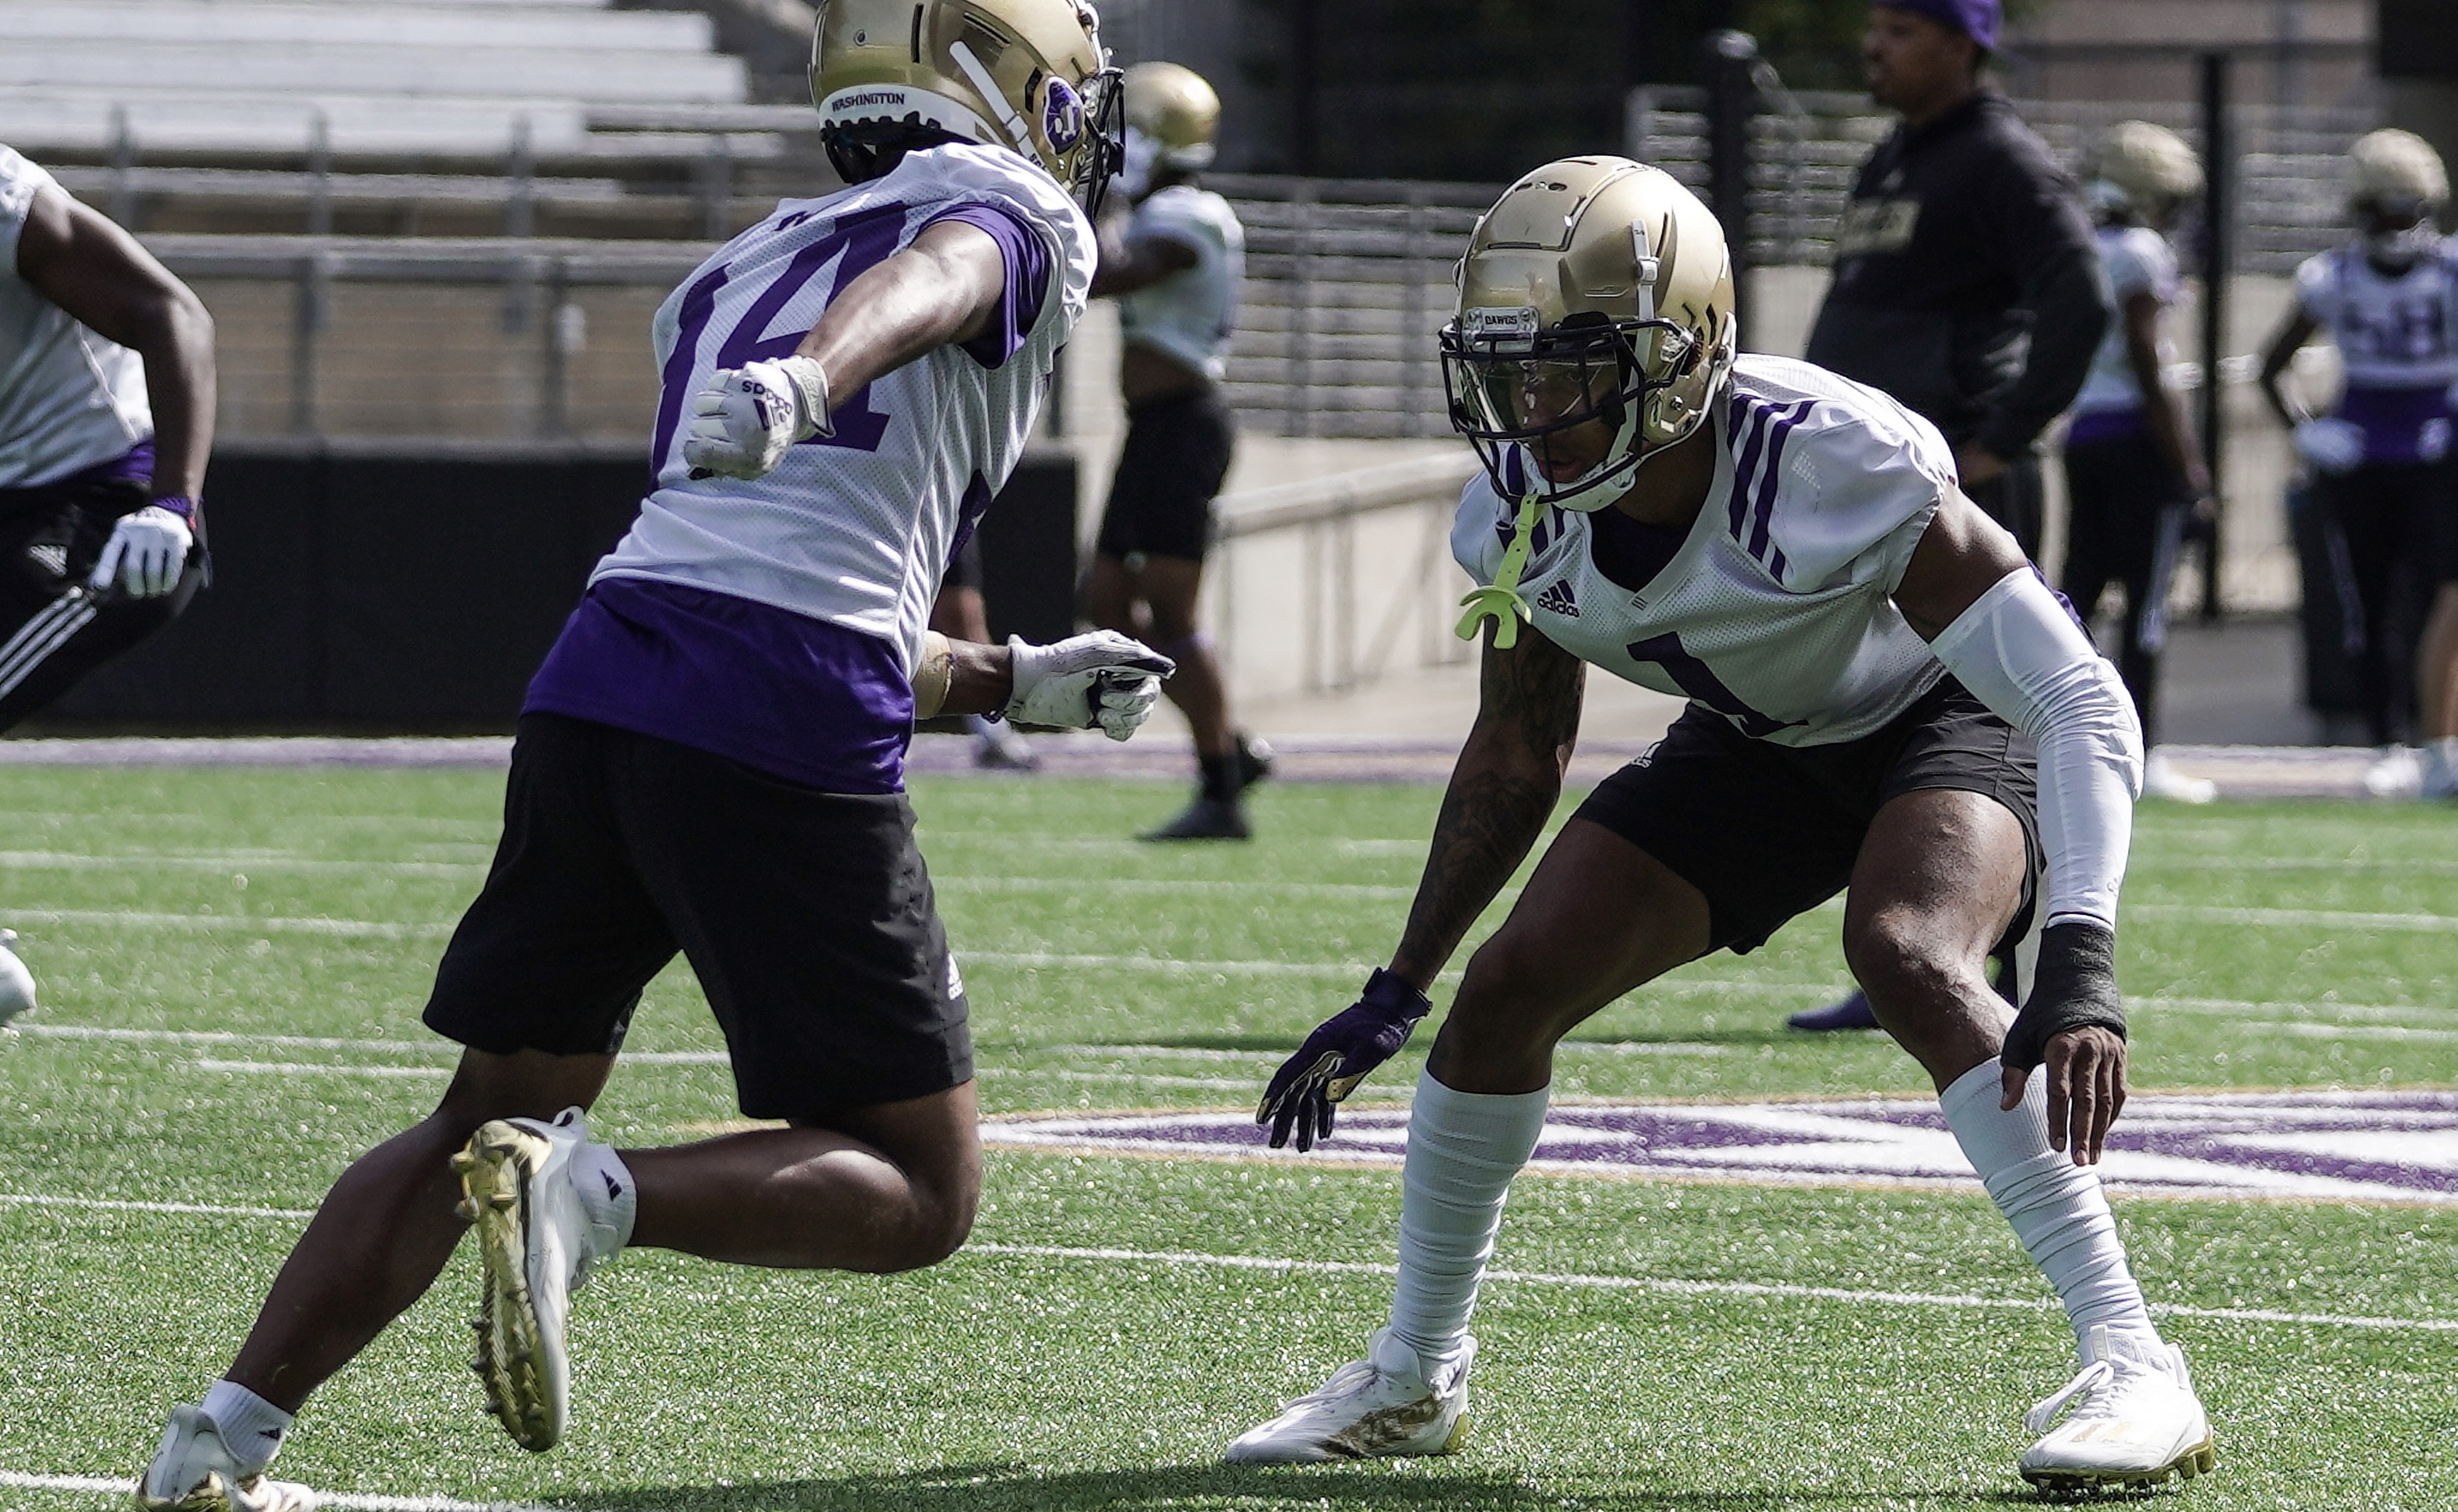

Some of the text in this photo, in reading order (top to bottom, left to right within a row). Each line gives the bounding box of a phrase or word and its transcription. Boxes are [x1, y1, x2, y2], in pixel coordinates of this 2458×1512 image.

[831, 93, 905, 112] WASHINGTON
[1537, 598, 1580, 618] adidas
[1626, 631, 1809, 737] 1
